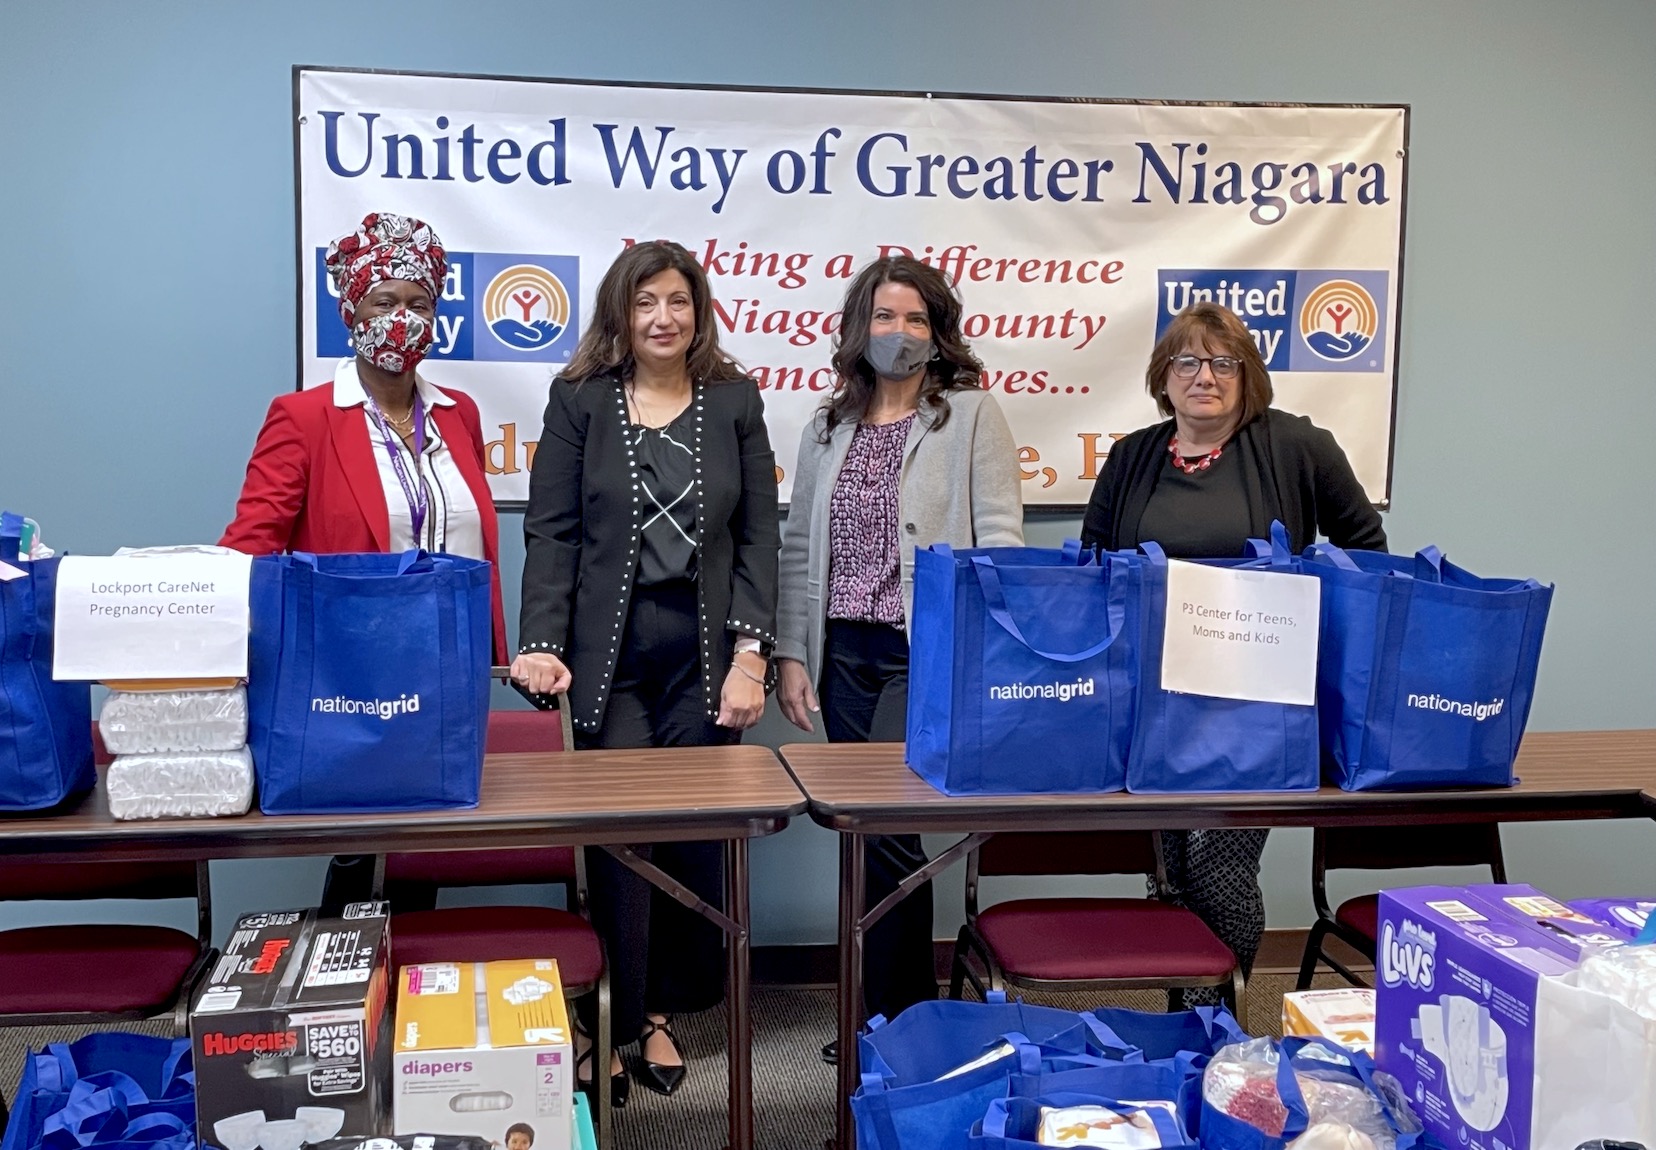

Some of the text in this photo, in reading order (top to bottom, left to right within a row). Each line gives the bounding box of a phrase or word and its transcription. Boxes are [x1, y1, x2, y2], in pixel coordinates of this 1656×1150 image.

[317, 110, 1390, 225] United Way of Greater Niagara
[824, 254, 854, 279] a
[1164, 279, 1286, 317] United
[963, 308, 1106, 350] ounty
[91, 581, 215, 597] Lockport CareNet
[90, 601, 216, 618] Pregnancy Center
[1182, 602, 1297, 627] P3 Center for Teens,
[1192, 625, 1280, 645] Moms and Kids
[990, 677, 1094, 702] nationalgrid
[311, 693, 420, 720] nationalgrid
[1407, 693, 1504, 721] nationalgrid
[309, 1025, 349, 1040] SAVE
[310, 1037, 360, 1058] $560
[402, 1061, 473, 1077] diapers
[544, 1072, 554, 1084] 2
